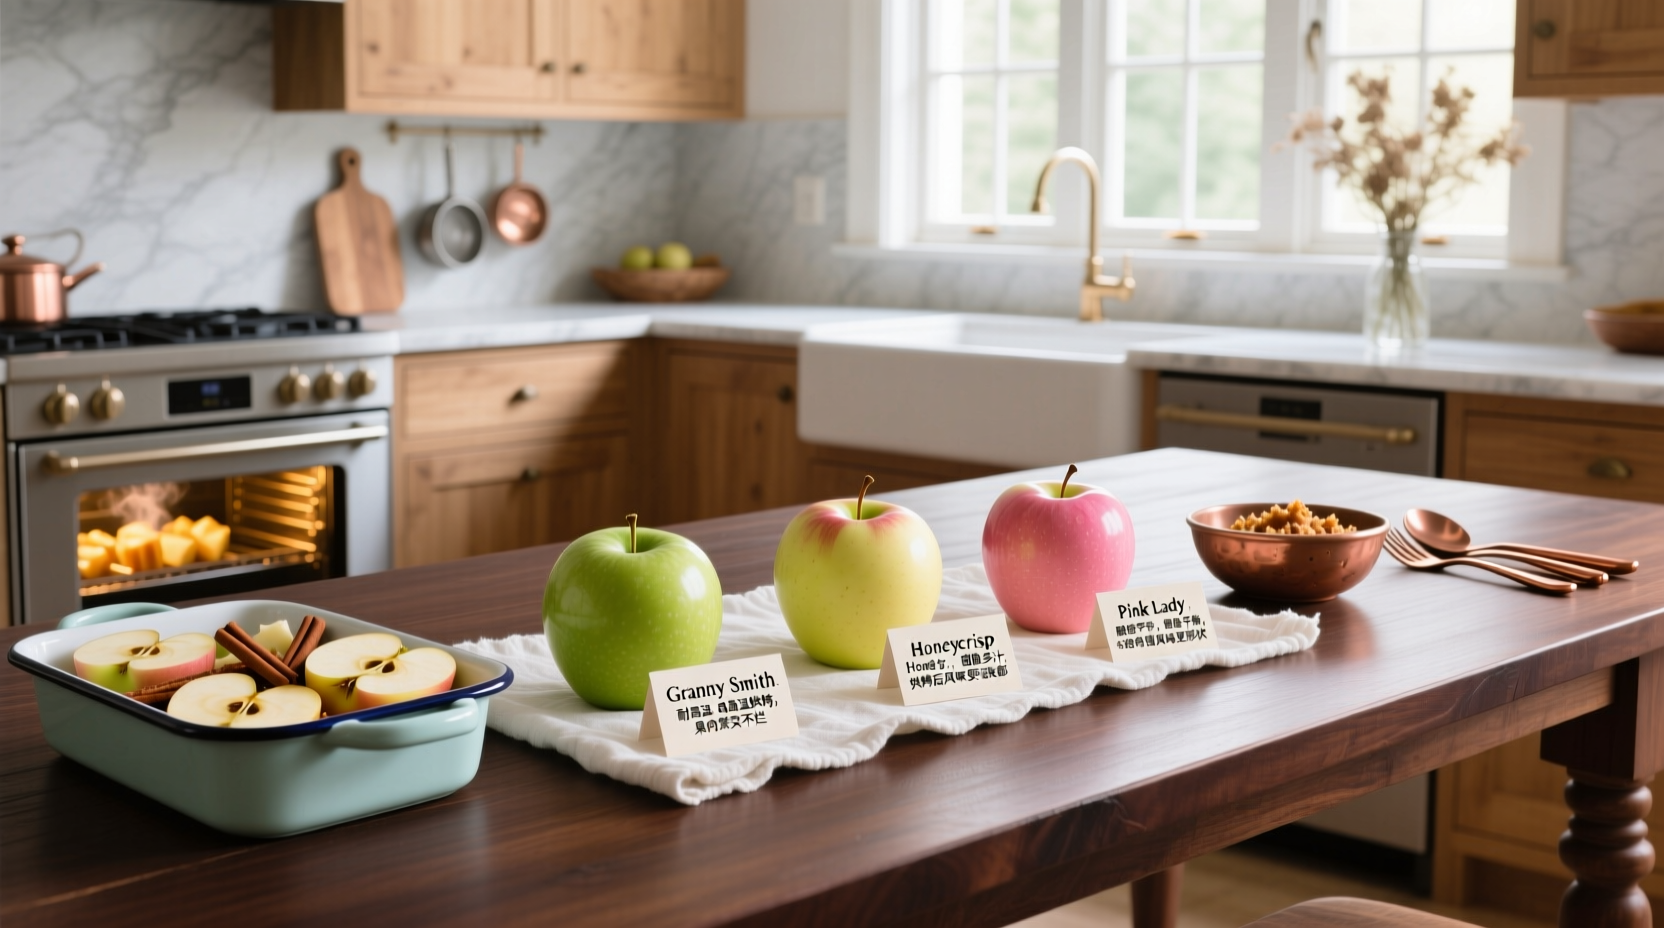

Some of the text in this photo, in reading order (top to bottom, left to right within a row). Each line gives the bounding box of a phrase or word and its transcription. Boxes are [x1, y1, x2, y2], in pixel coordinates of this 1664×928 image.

[1117, 600, 1150, 619] Pink
[911, 633, 995, 657] Honeycrisp
[666, 682, 725, 703] Granny
